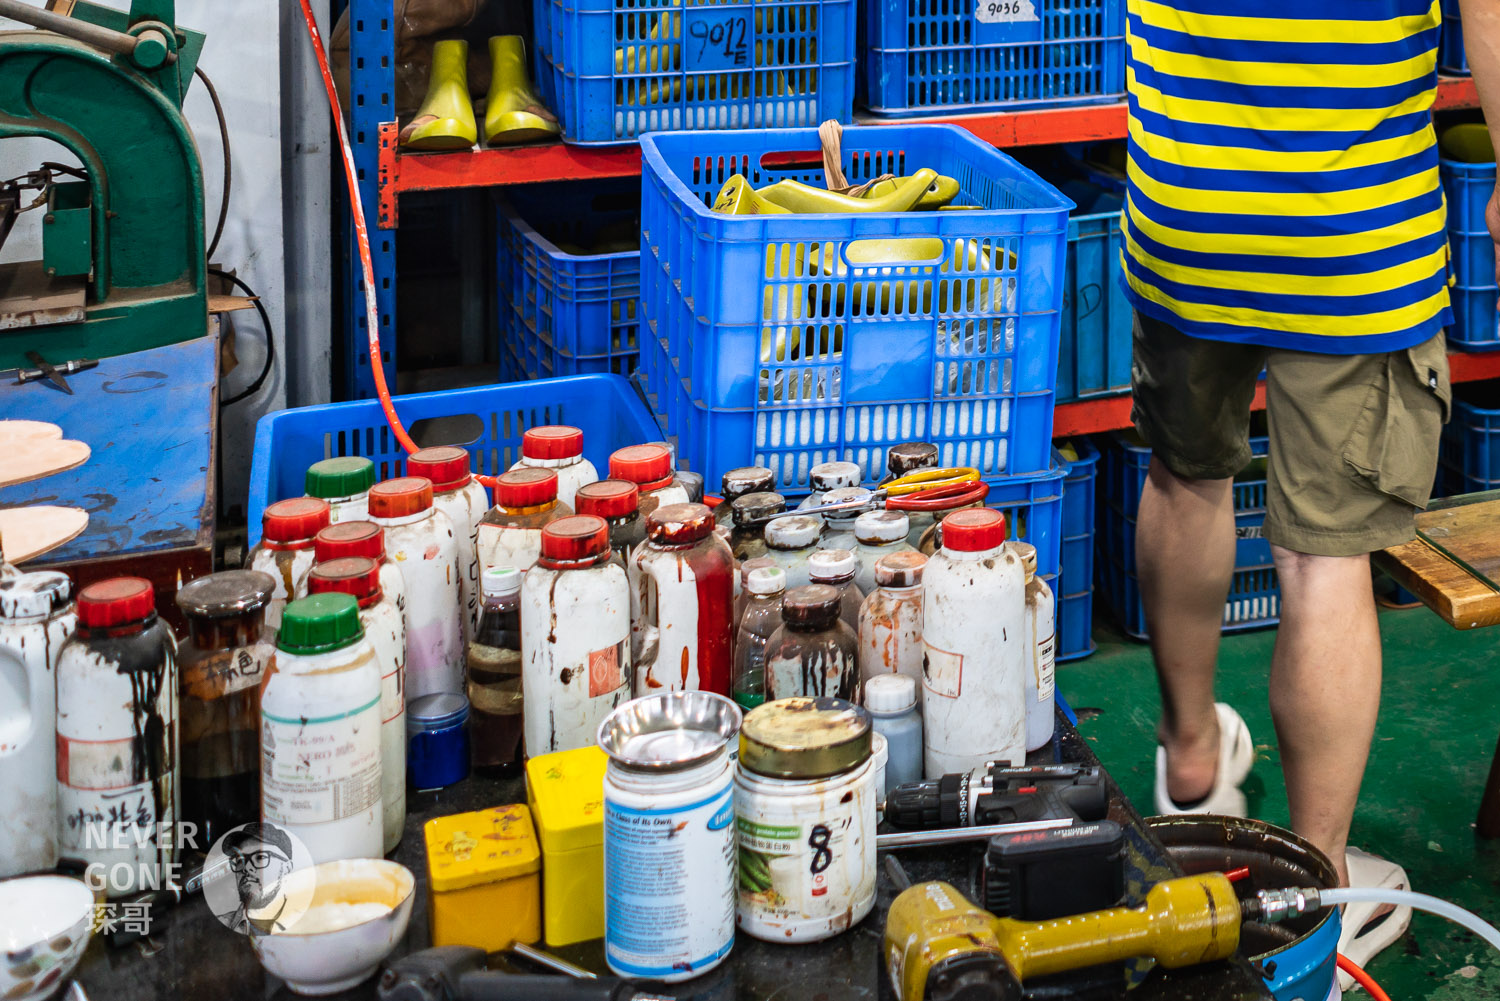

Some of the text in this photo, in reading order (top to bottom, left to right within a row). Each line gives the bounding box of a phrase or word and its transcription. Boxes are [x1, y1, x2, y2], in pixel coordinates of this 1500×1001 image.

[988, 0, 1021, 17] 9036
[690, 17, 748, 64] 9012
[653, 817, 672, 826] Own
[776, 827, 799, 838] powder
[809, 824, 832, 876] 8
